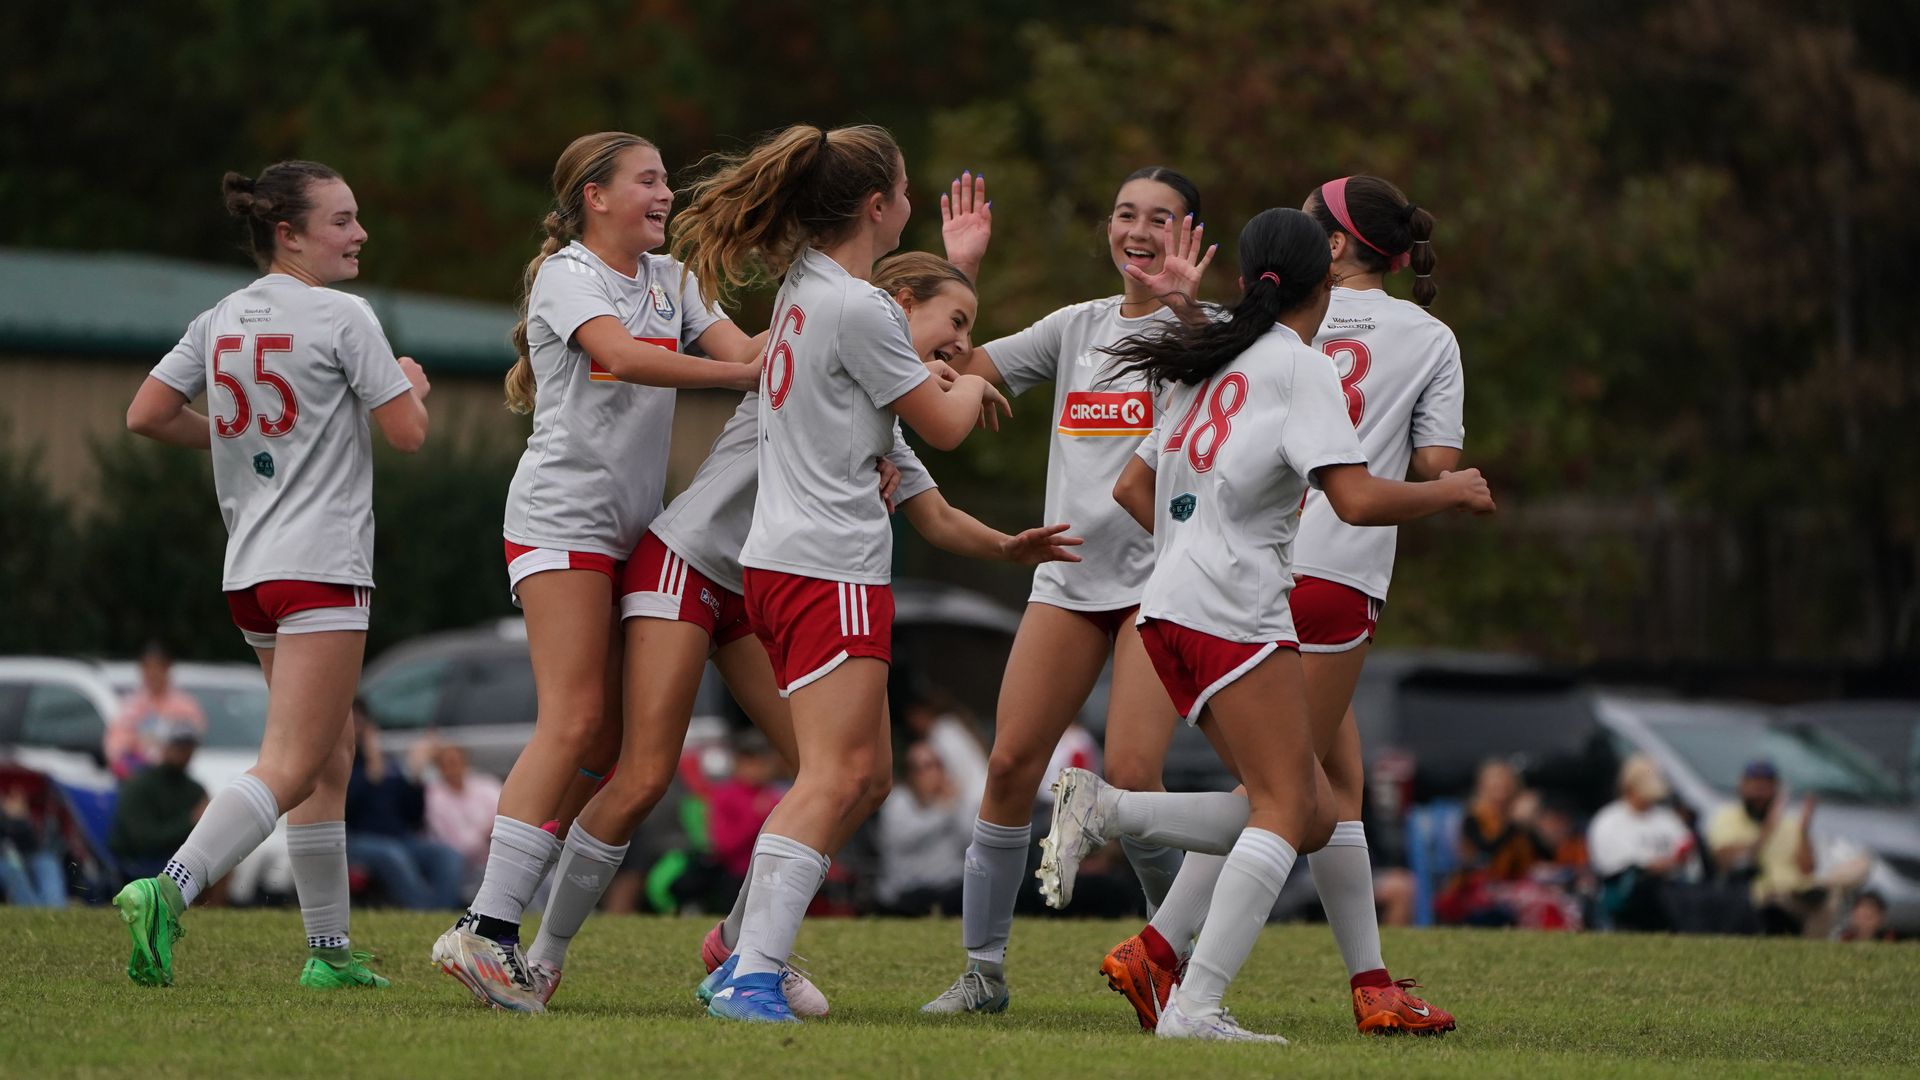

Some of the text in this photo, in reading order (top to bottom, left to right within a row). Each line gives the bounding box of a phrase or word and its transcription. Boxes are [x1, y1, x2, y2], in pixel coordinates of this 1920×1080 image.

[212, 334, 299, 439] 55
[1070, 403, 1118, 420] CIRCLE
[1162, 371, 1249, 474] 48
